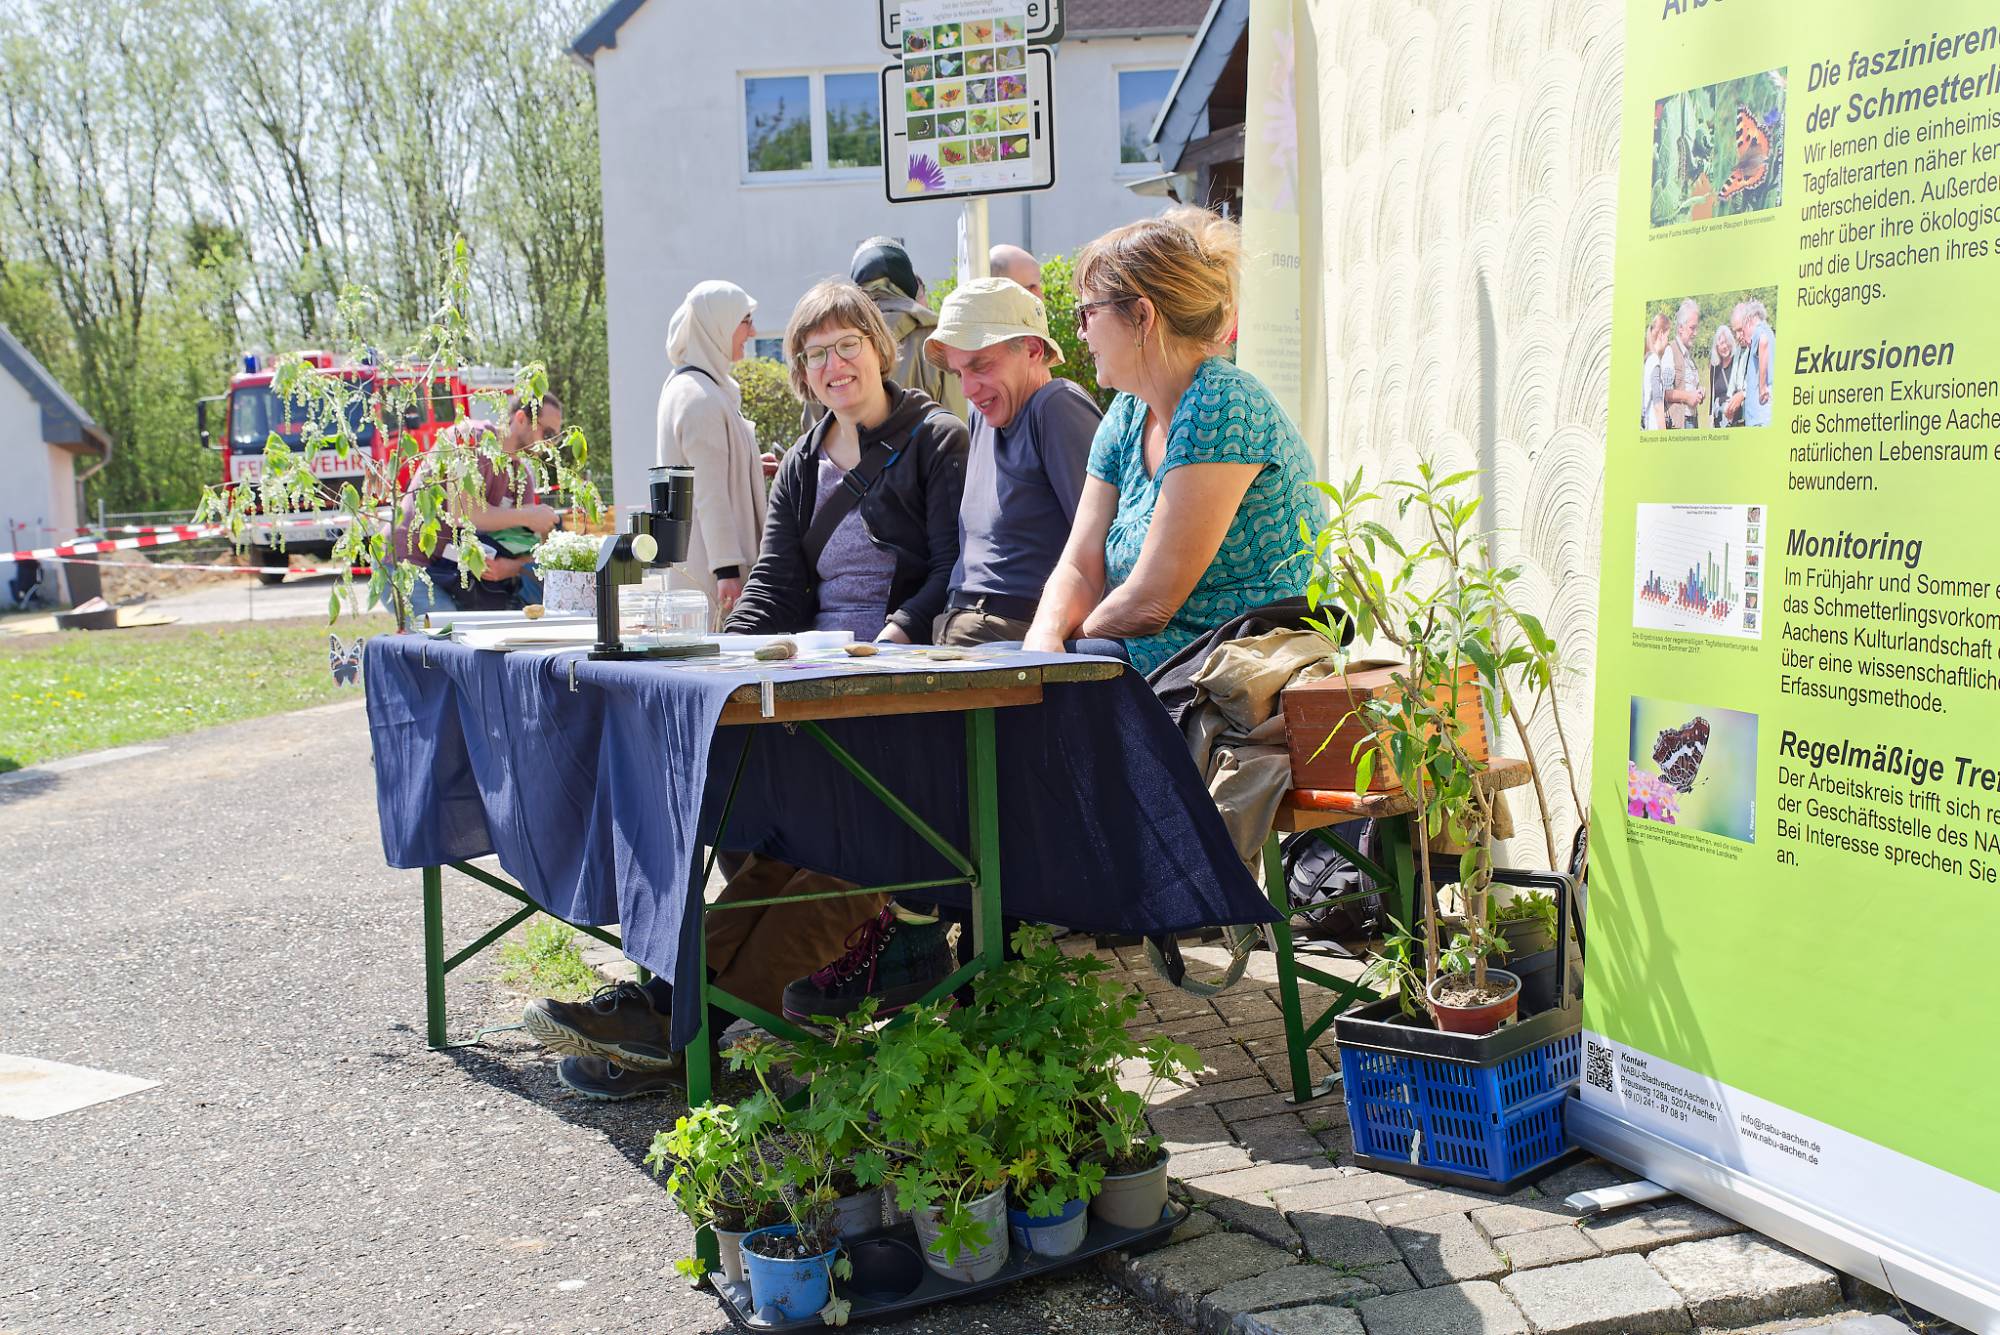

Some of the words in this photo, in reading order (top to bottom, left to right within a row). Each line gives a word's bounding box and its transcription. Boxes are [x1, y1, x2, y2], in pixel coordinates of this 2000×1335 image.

[1807, 59, 1841, 92] Die
[1804, 142, 1827, 164] Wir
[1829, 135, 1878, 159] lernen
[1884, 126, 1910, 148] die
[1916, 108, 2000, 143] einheimis
[1806, 104, 1841, 134] der
[1803, 158, 1907, 195] Tagfalterarten
[1914, 148, 1967, 174] näher
[1801, 188, 1915, 222] unterscheiden.
[1800, 227, 1835, 250] mehr
[1839, 222, 1875, 245] über
[1881, 217, 1914, 239] ihre
[1799, 256, 1823, 279] und
[1827, 254, 1850, 275] die
[1856, 244, 1939, 271] Ursachen
[1946, 239, 1988, 261] ihres
[1797, 282, 1886, 308] Rückgangs.
[1794, 340, 1954, 375] Exkursionen
[1792, 385, 1814, 406] Bei
[1819, 385, 1884, 405] unseren
[1890, 377, 1998, 402] Exkursionen
[1791, 414, 1811, 434] die
[1815, 409, 1941, 436] Schmetterlinge
[1789, 442, 1873, 463] natürlichen
[1879, 440, 1988, 462] Lebensraum
[1788, 471, 1878, 491] bewundern.
[1786, 528, 1923, 569] Monitoring
[1784, 566, 1801, 586] Im
[1806, 567, 1874, 594] Frühjahr
[1879, 573, 1911, 593] und
[1917, 573, 1991, 599] Sommer
[1783, 594, 1809, 614] das
[1782, 621, 1848, 646] Aachens
[1854, 627, 1992, 660] Kulturlandschaft
[1781, 648, 1814, 669] über
[1819, 652, 1853, 673] eine
[1781, 675, 1947, 714] Erfassungsmethode.
[1779, 730, 1944, 785] Regelmäßige
[1778, 766, 1805, 787] Der
[1808, 772, 1903, 806] Arbeitskreis
[1909, 789, 1941, 813] trifft
[1946, 797, 1980, 821] sich
[1777, 794, 1801, 814] der
[1806, 798, 1932, 840] Geschäftsstelle
[1937, 824, 1968, 848] des
[1776, 849, 1799, 867] an.
[1777, 818, 1801, 841] Bei
[1806, 824, 1879, 857] Interesse
[1885, 845, 1963, 876] sprechen
[1969, 858, 1997, 884] Sie
[1620, 1052, 1648, 1070] Kontakt
[1620, 1063, 1683, 1096] NABU-Stadtverband
[1684, 1089, 1709, 1107] Aachen
[1620, 1075, 1651, 1096] Preusweg
[1671, 1097, 1691, 1111] 52074
[1691, 1104, 1718, 1123] Aachen
[1660, 1103, 1669, 1114] 87
[1740, 1112, 1821, 1153] info@nabu-aachen.de
[1740, 1126, 1819, 1165] www.nabu-aachen.de
